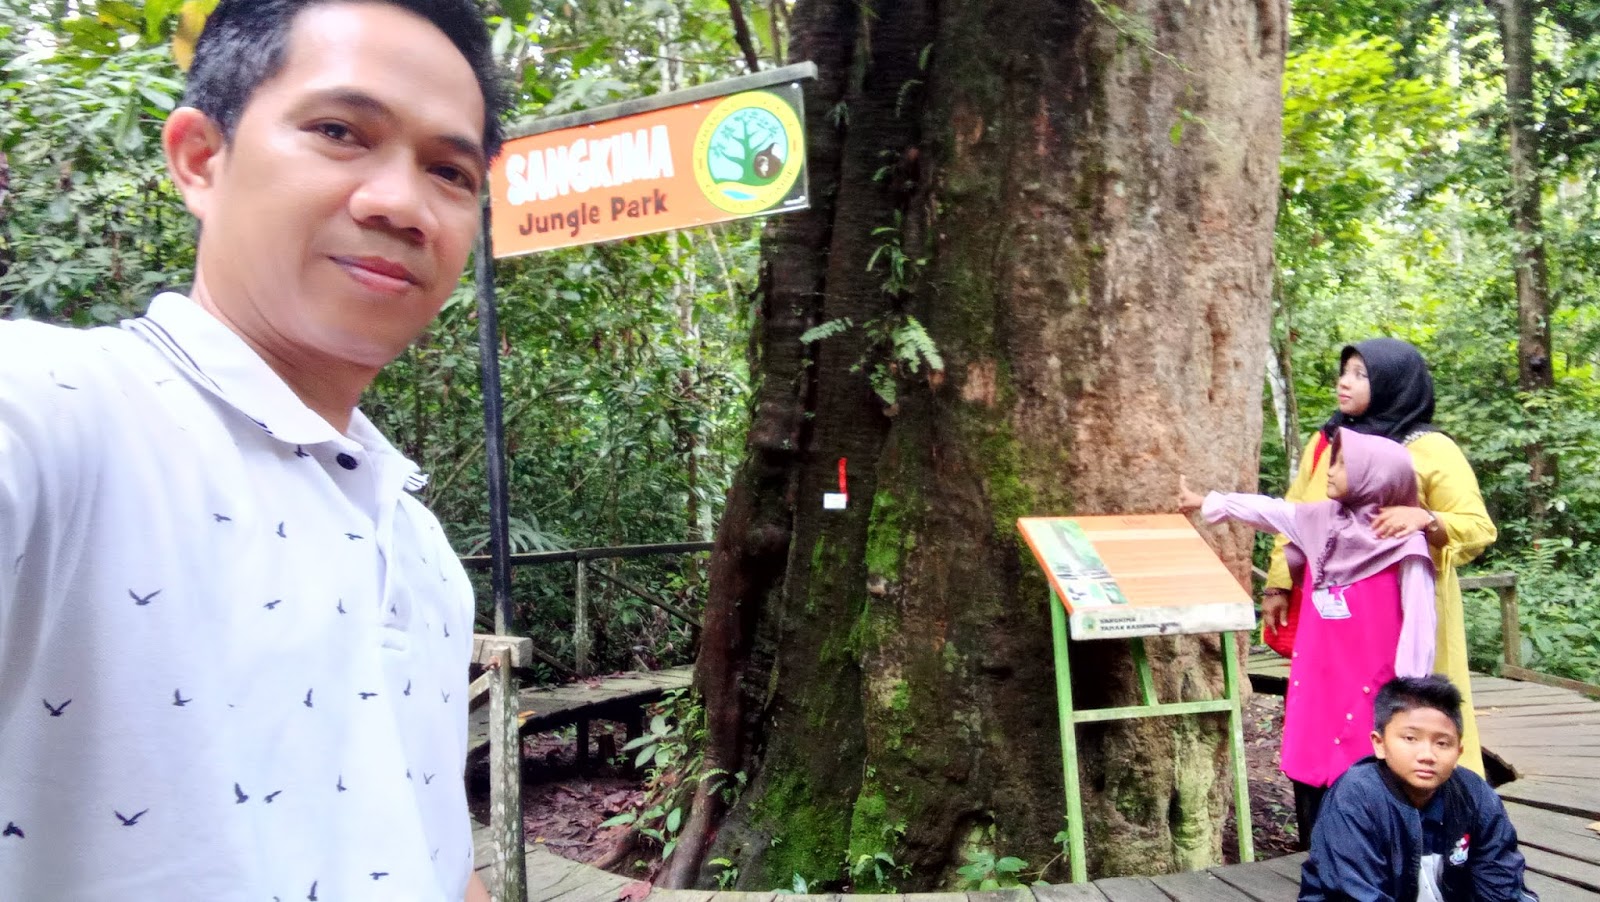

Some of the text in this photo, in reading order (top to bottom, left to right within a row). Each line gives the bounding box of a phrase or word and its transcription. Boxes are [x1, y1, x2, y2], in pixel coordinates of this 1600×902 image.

[506, 125, 675, 206] SANGKIMA
[519, 189, 669, 237] Jungle Park
